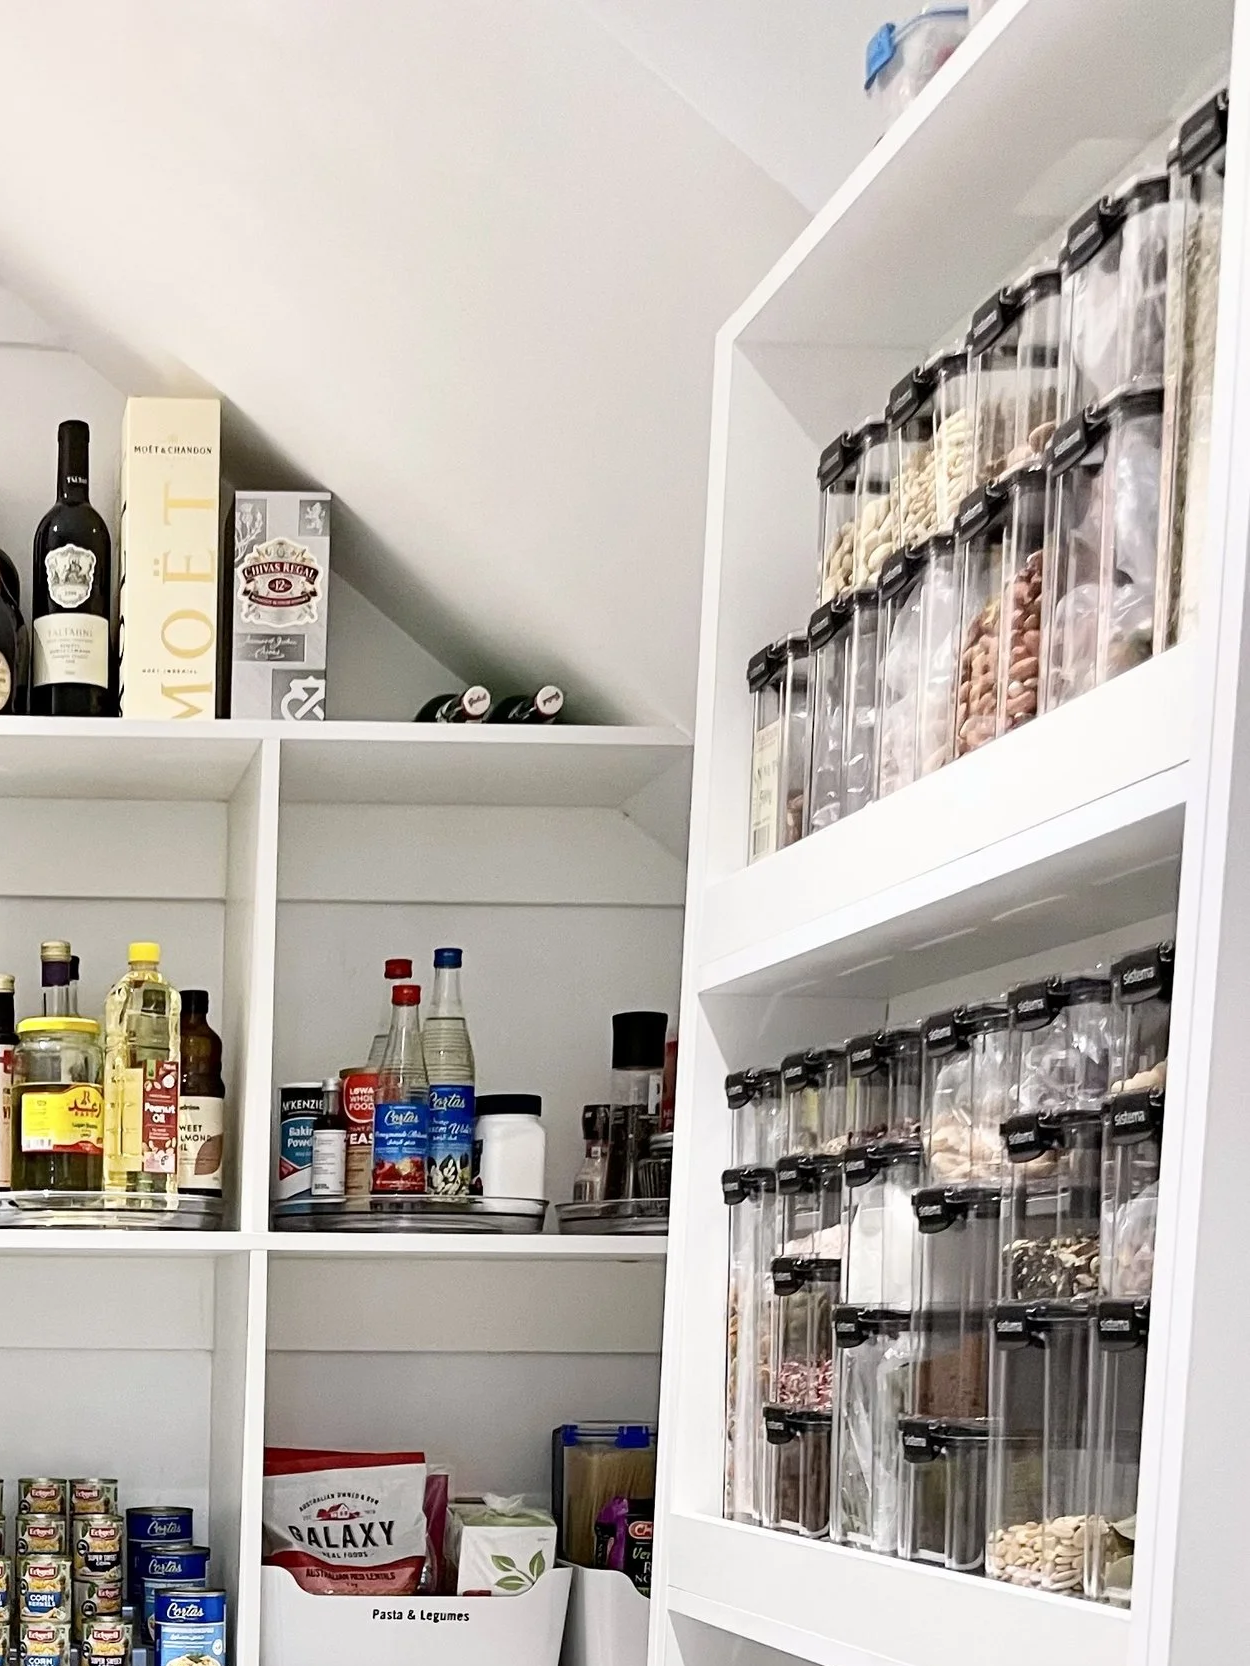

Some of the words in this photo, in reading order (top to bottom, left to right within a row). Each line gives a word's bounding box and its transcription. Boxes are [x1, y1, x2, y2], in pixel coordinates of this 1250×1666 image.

[167, 445, 213, 455] CHANDON
[243, 561, 281, 580] CHIVAS
[283, 561, 316, 580] REGAL
[274, 579, 285, 591] 12
[1122, 965, 1156, 986] sistema
[349, 1094, 375, 1103] WHOL
[144, 1102, 176, 1114] Peanut
[151, 1113, 166, 1124] Oil
[1113, 1110, 1146, 1128] sistema
[179, 1124, 203, 1133] WEET
[287, 1519, 395, 1549] GALAXY
[148, 1558, 183, 1575] Cortas
[166, 1602, 205, 1620] Cortas
[372, 1608, 404, 1621] Pasta
[407, 1609, 416, 1621] &
[420, 1609, 470, 1623] Legumes
[28, 1631, 54, 1642] Edgell
[93, 1631, 119, 1642] Edgell
